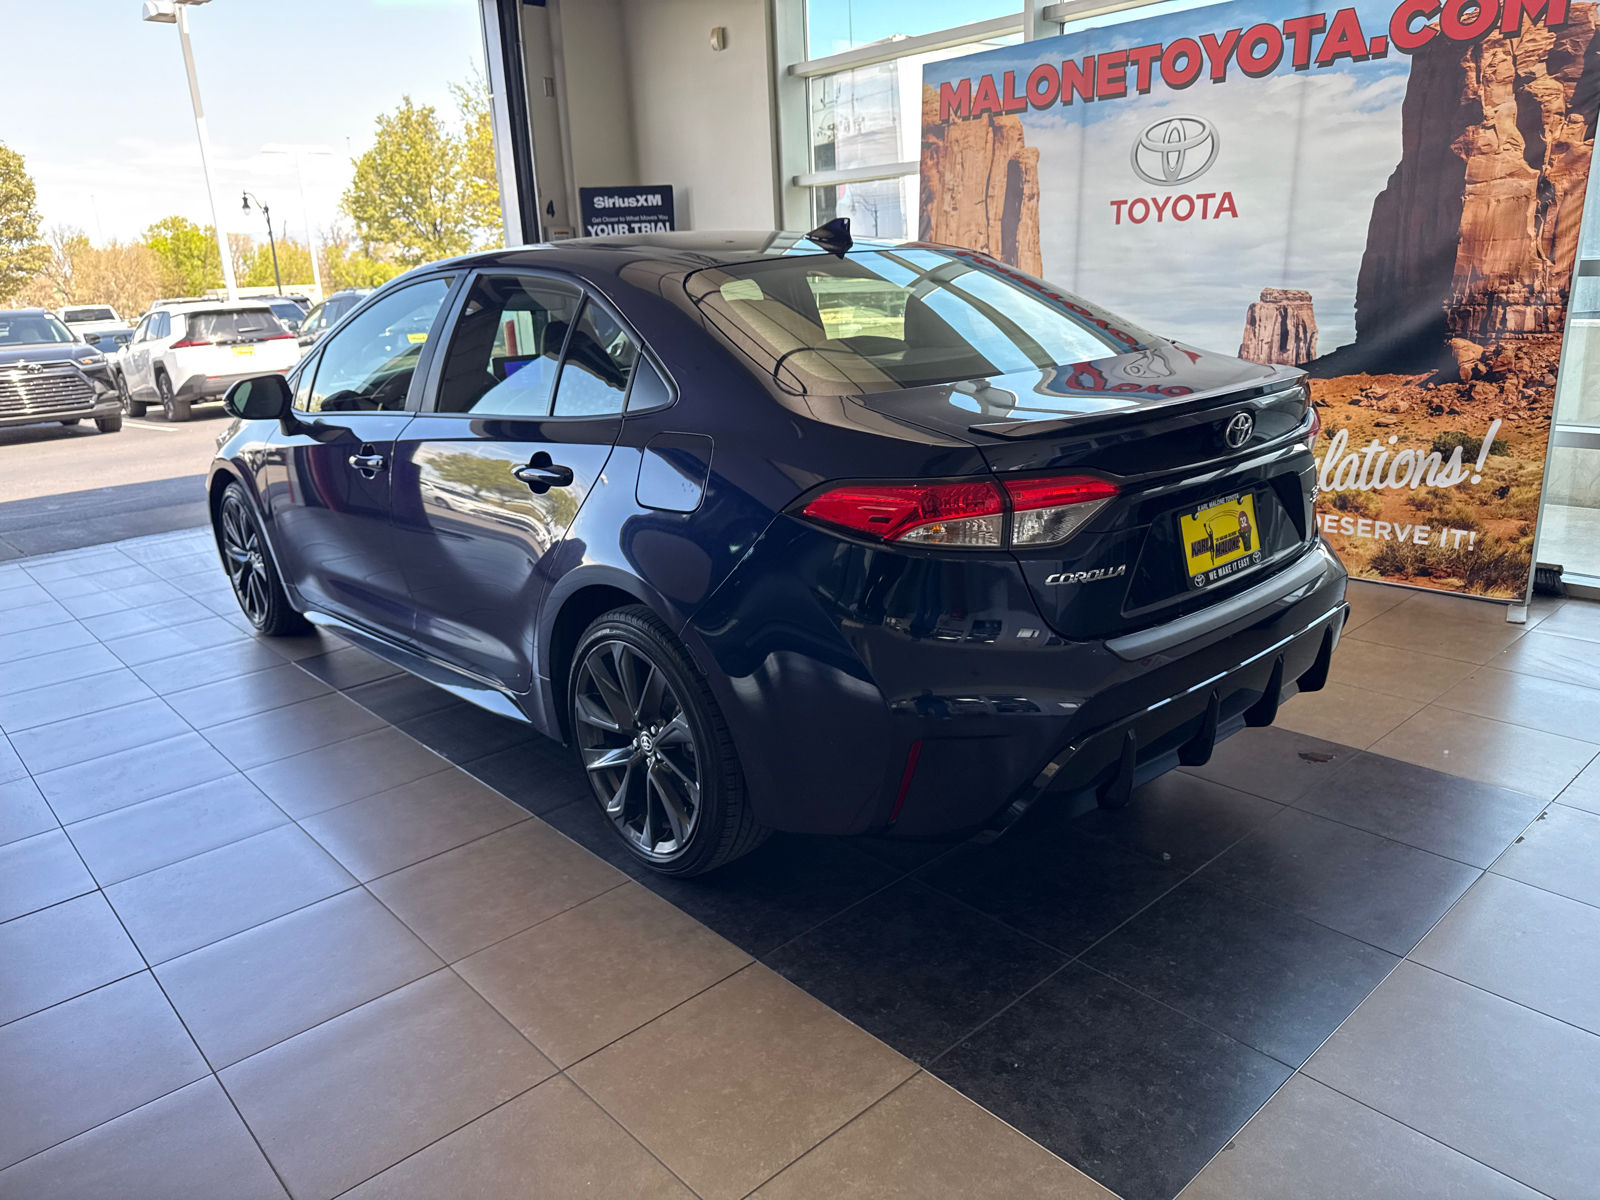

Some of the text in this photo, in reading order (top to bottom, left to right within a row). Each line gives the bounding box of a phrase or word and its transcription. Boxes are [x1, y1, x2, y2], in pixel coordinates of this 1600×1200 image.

[939, 0, 1571, 121] MALONETOYOTA.COM
[546, 200, 556, 218] 4
[593, 194, 662, 209] SiriusXM
[1110, 191, 1238, 226] TOYOTA
[587, 223, 629, 237] YOUR
[1315, 418, 1502, 492] lations!
[1197, 502, 1209, 512] KARL
[1209, 497, 1225, 509] MALONE
[1240, 516, 1247, 528] 32
[1191, 536, 1210, 558] KARL
[1215, 535, 1241, 559] MALONE
[1440, 528, 1477, 551] IT!
[1045, 564, 1126, 586] COROLLA
[1208, 557, 1250, 581] WE MAKE IT EASY
